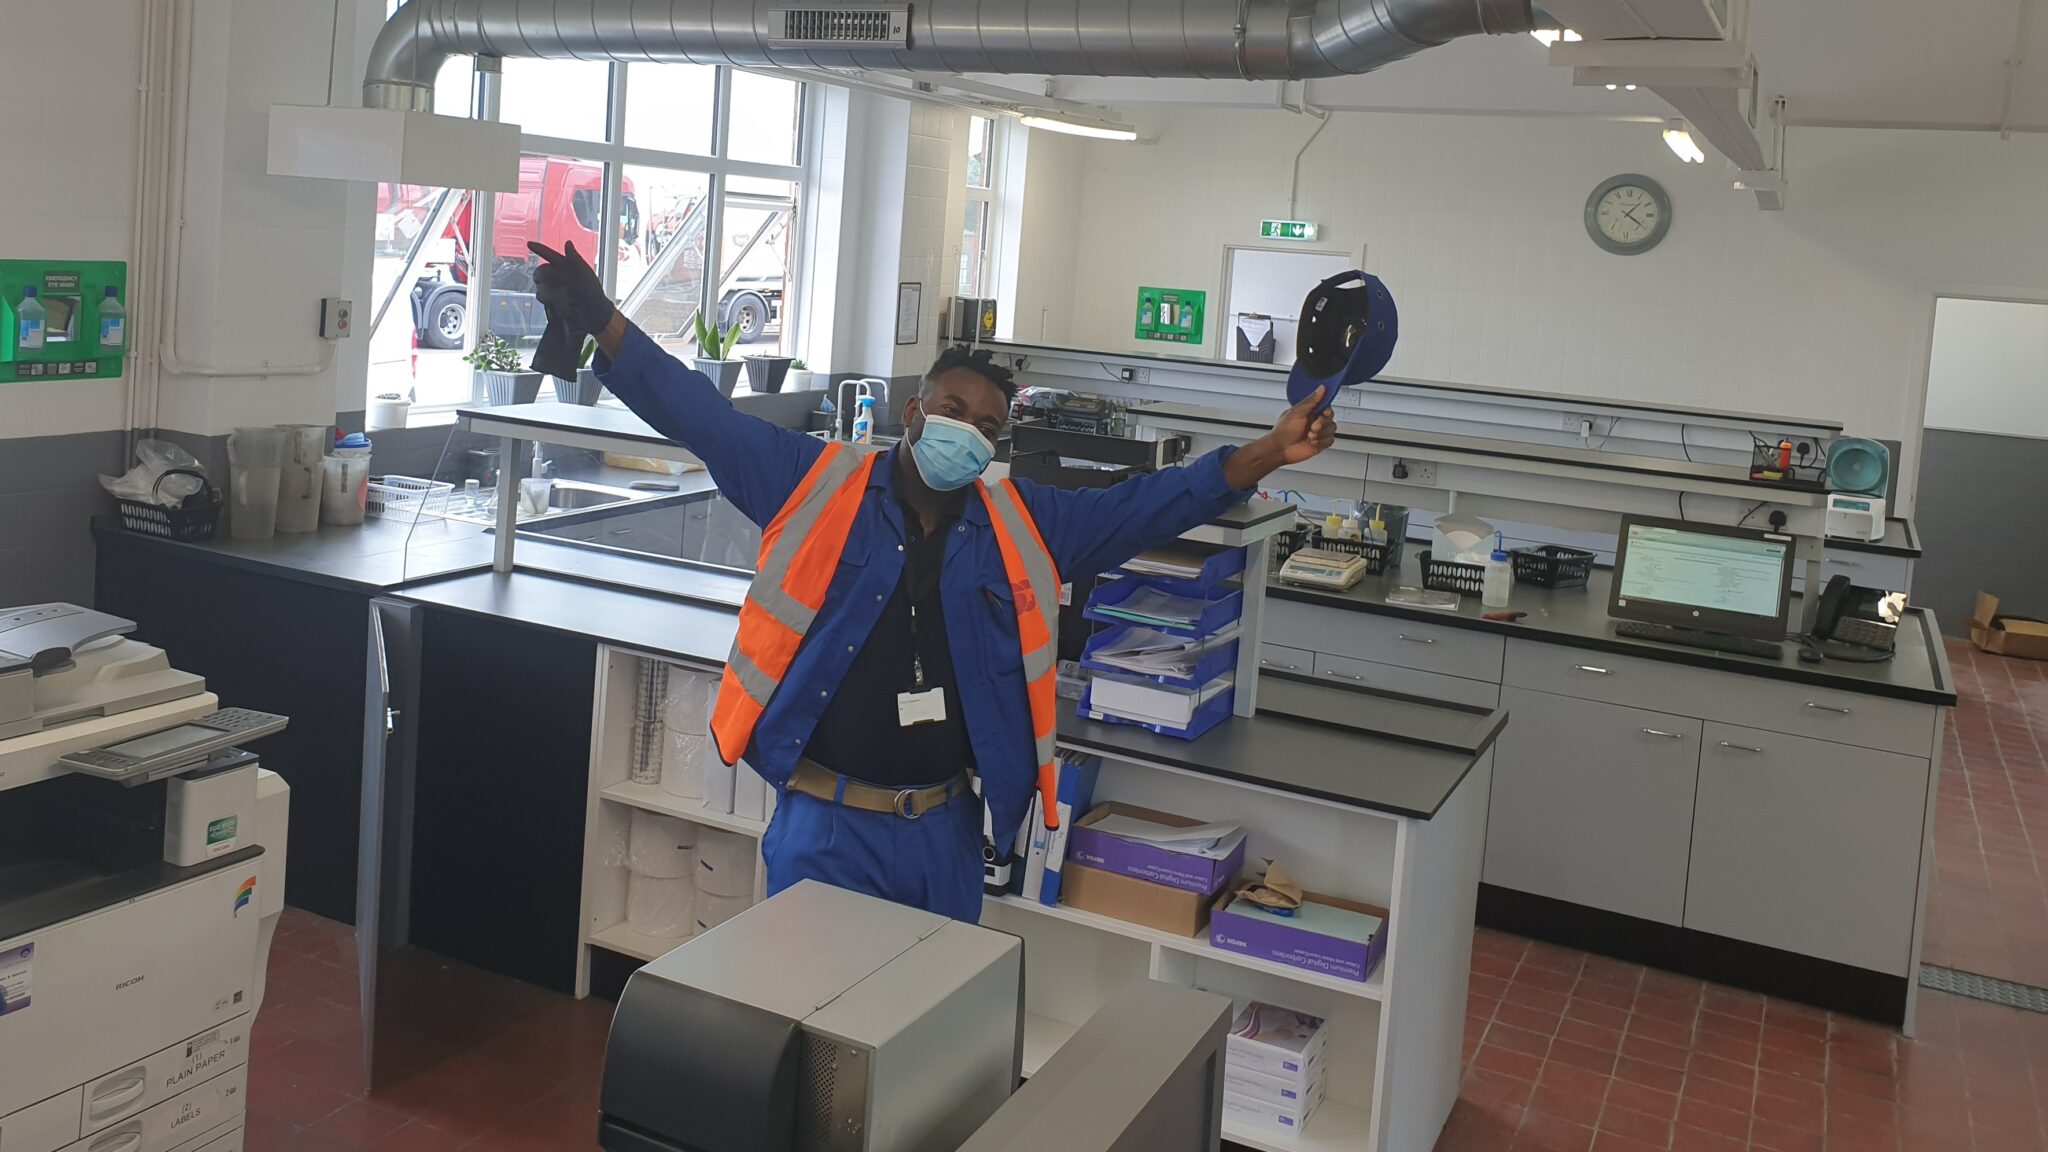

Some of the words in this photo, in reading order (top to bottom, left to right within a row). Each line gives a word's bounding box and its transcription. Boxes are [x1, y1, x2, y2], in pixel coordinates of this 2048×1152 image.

[1086, 854, 1105, 864] xerox
[1127, 865, 1159, 879] Carbonless
[1160, 873, 1179, 884] Digital
[1180, 879, 1208, 890] Premium
[1226, 937, 1247, 948] xerox
[1271, 950, 1307, 964] Carbonless
[1307, 958, 1330, 969] Digital
[1330, 964, 1360, 977] Premium
[115, 974, 145, 990] RICOH
[166, 1067, 193, 1088] PLAIN
[195, 1050, 226, 1073] PAPER
[181, 1102, 192, 1114] (2)
[170, 1107, 201, 1129] LABELS
